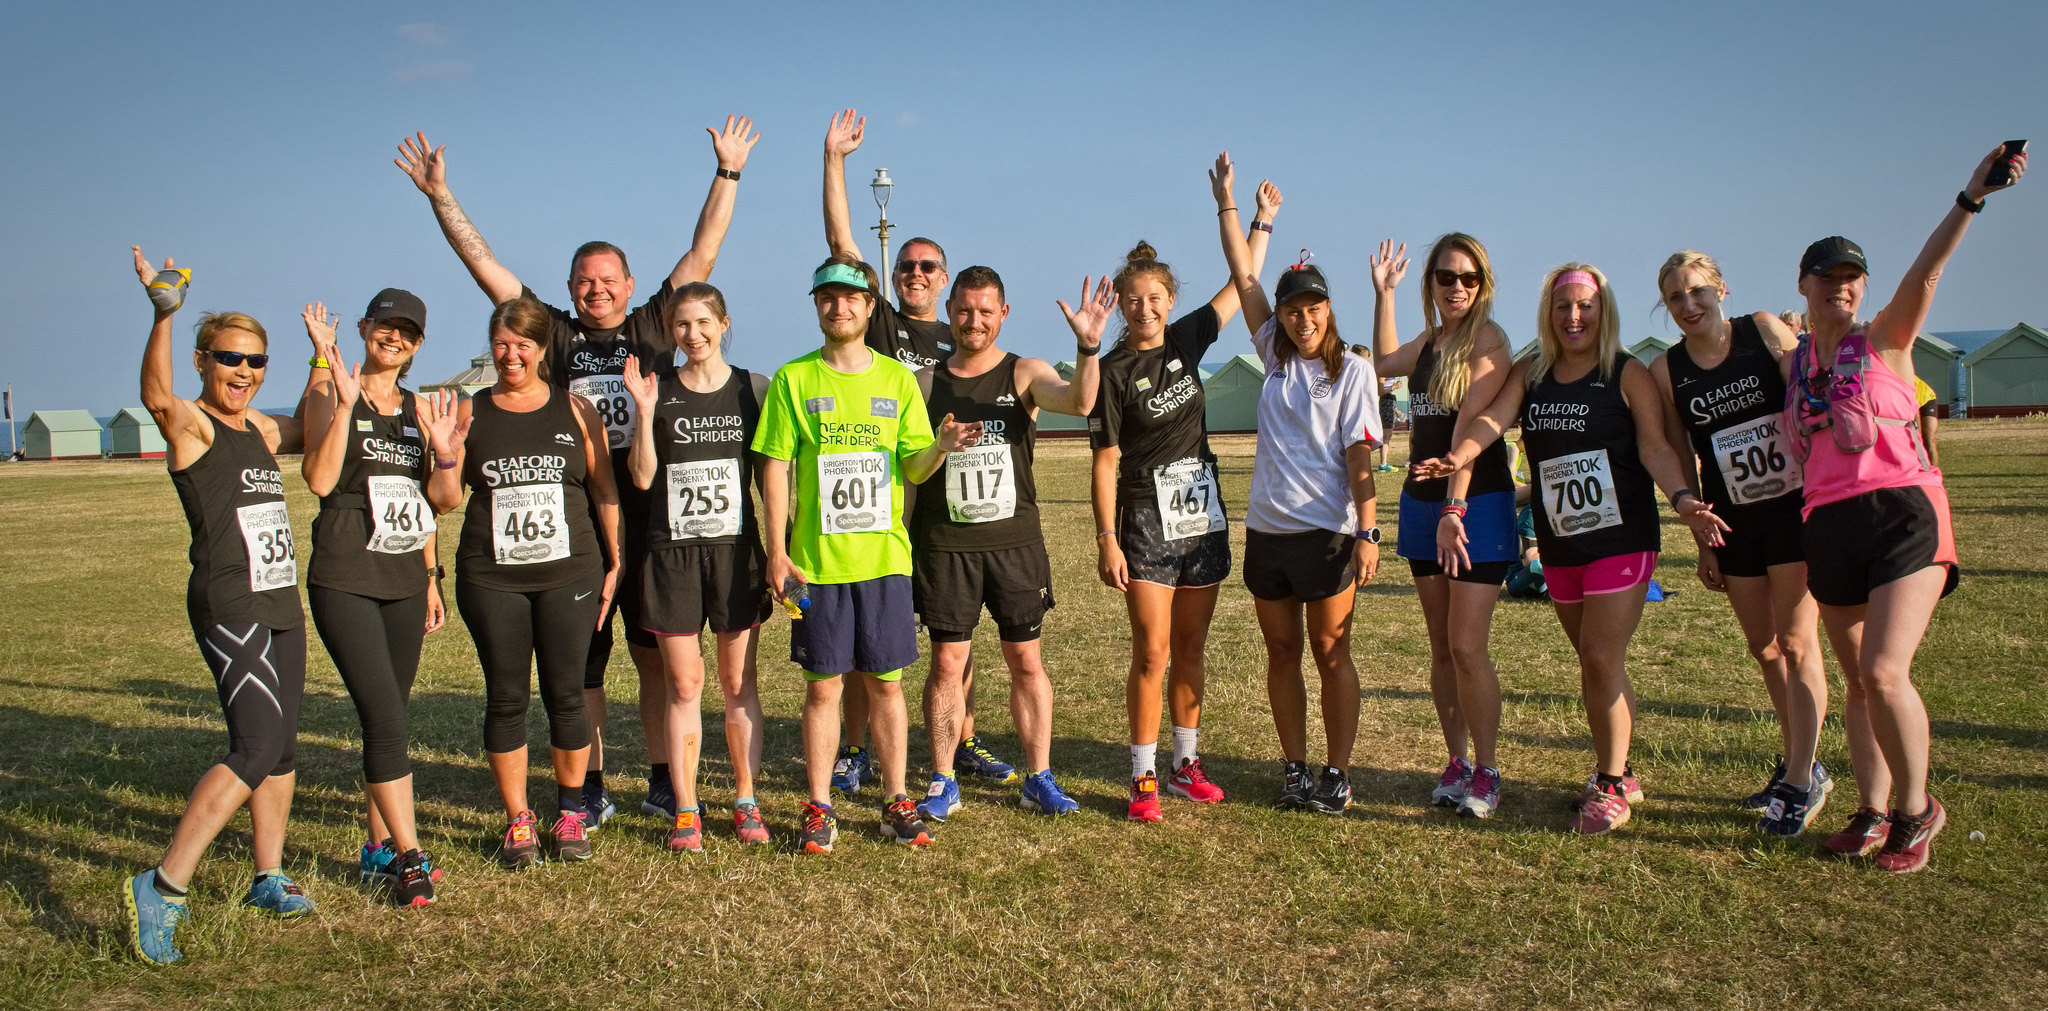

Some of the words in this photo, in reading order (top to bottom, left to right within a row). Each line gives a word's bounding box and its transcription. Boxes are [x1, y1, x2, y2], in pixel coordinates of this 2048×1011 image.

[572, 381, 605, 391] BRIGHTON
[1148, 375, 1193, 411] SEAFORD
[1690, 375, 1760, 406] SEAFORD
[1526, 403, 1590, 419] SEAFORD
[674, 416, 742, 432] SEAFORD
[1716, 429, 1753, 444] BRIGHTON
[1752, 420, 1781, 441] 10K
[674, 428, 743, 444] STRIDERS
[1718, 435, 1755, 451] PHOENIX
[362, 438, 422, 458] SEAFORD
[481, 455, 566, 475] SEAFORD
[823, 459, 859, 468] BRIGHTON
[858, 458, 883, 473] 10K
[949, 453, 981, 462] BRIGHTON
[980, 451, 1005, 466] 10K
[949, 460, 981, 469] PHOENIX
[1543, 461, 1574, 475] BRIGHTON
[1573, 457, 1602, 475] 10K
[1730, 441, 1786, 482] 506
[482, 467, 564, 487] STRIDERS
[672, 468, 705, 477] BRIGHTON
[704, 465, 731, 481] 10K
[824, 466, 859, 475] PHOENIX
[1190, 469, 1210, 483] 10K
[1543, 469, 1575, 482] PHOENIX
[374, 482, 408, 490] BRIGHTON
[672, 475, 705, 484] PHOENIX
[960, 468, 1004, 501] 117
[375, 490, 408, 498] PHOENIX
[496, 492, 531, 502] BRIGHTON
[531, 490, 557, 506] 10K
[679, 483, 730, 517] 255
[832, 477, 877, 510] 601
[1170, 485, 1210, 516] 467
[1551, 475, 1603, 514] 700
[496, 500, 531, 509] PHOENIX
[963, 506, 997, 516] Specsavers
[247, 516, 280, 530] PHOENIX
[384, 502, 423, 532] 461
[838, 516, 873, 525] Specsavers
[504, 509, 557, 543] 463
[258, 527, 296, 565] 358
[511, 547, 550, 558] Specsavers
